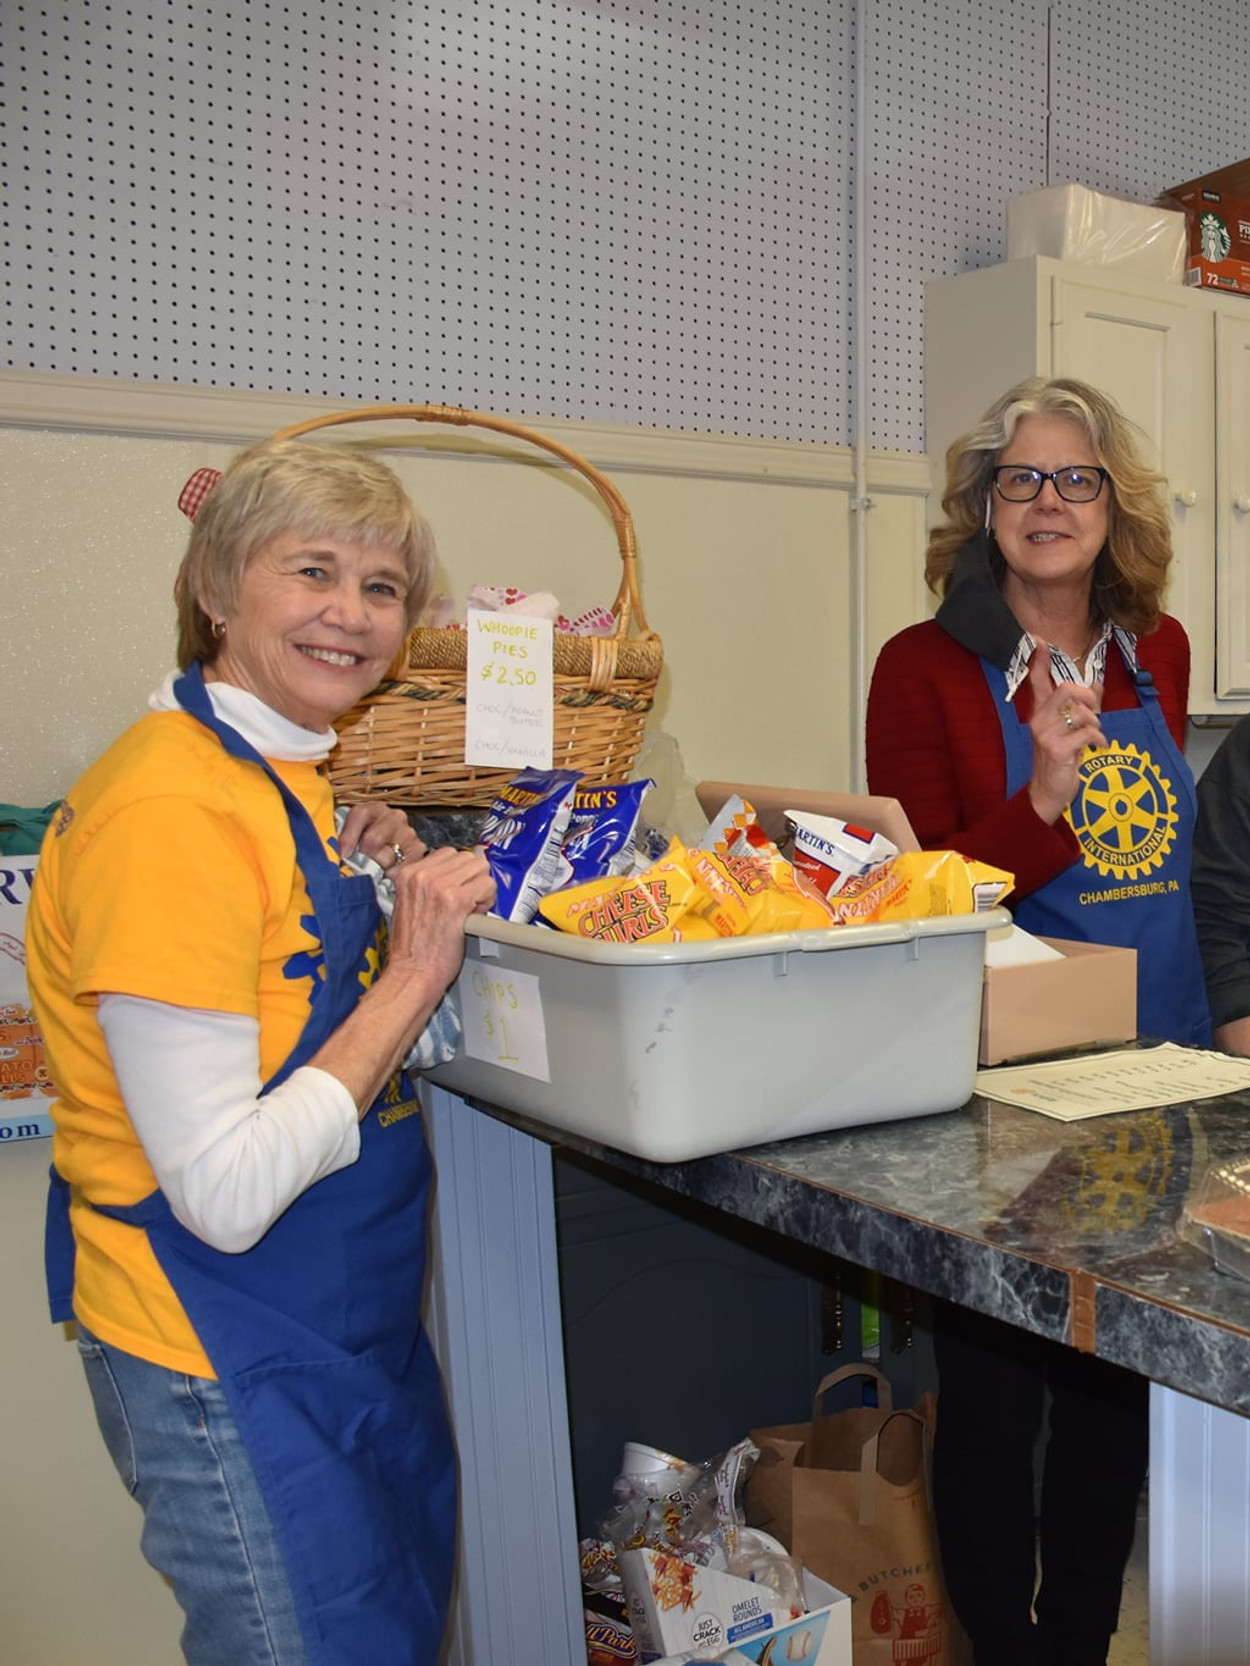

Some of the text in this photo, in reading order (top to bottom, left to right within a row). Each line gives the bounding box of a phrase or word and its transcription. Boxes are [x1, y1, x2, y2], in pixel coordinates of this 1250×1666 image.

[1207, 273, 1220, 285] 72
[477, 619, 539, 640] WHOOPIE
[492, 640, 528, 659] PIES
[1084, 755, 1133, 773] ROTARY
[574, 790, 617, 809] TIN'S
[1084, 826, 1166, 866] INTERNATIONAL
[1168, 880, 1179, 892] PA
[578, 880, 671, 938] CHEESE
[592, 905, 669, 943] URLS
[472, 970, 518, 1010] CHIPS
[732, 1597, 759, 1614] OMELET
[733, 1606, 762, 1623] ROUNDS
[693, 1626, 721, 1642] CRACK
[699, 1619, 713, 1632] JUST
[707, 1635, 720, 1647] EGG
